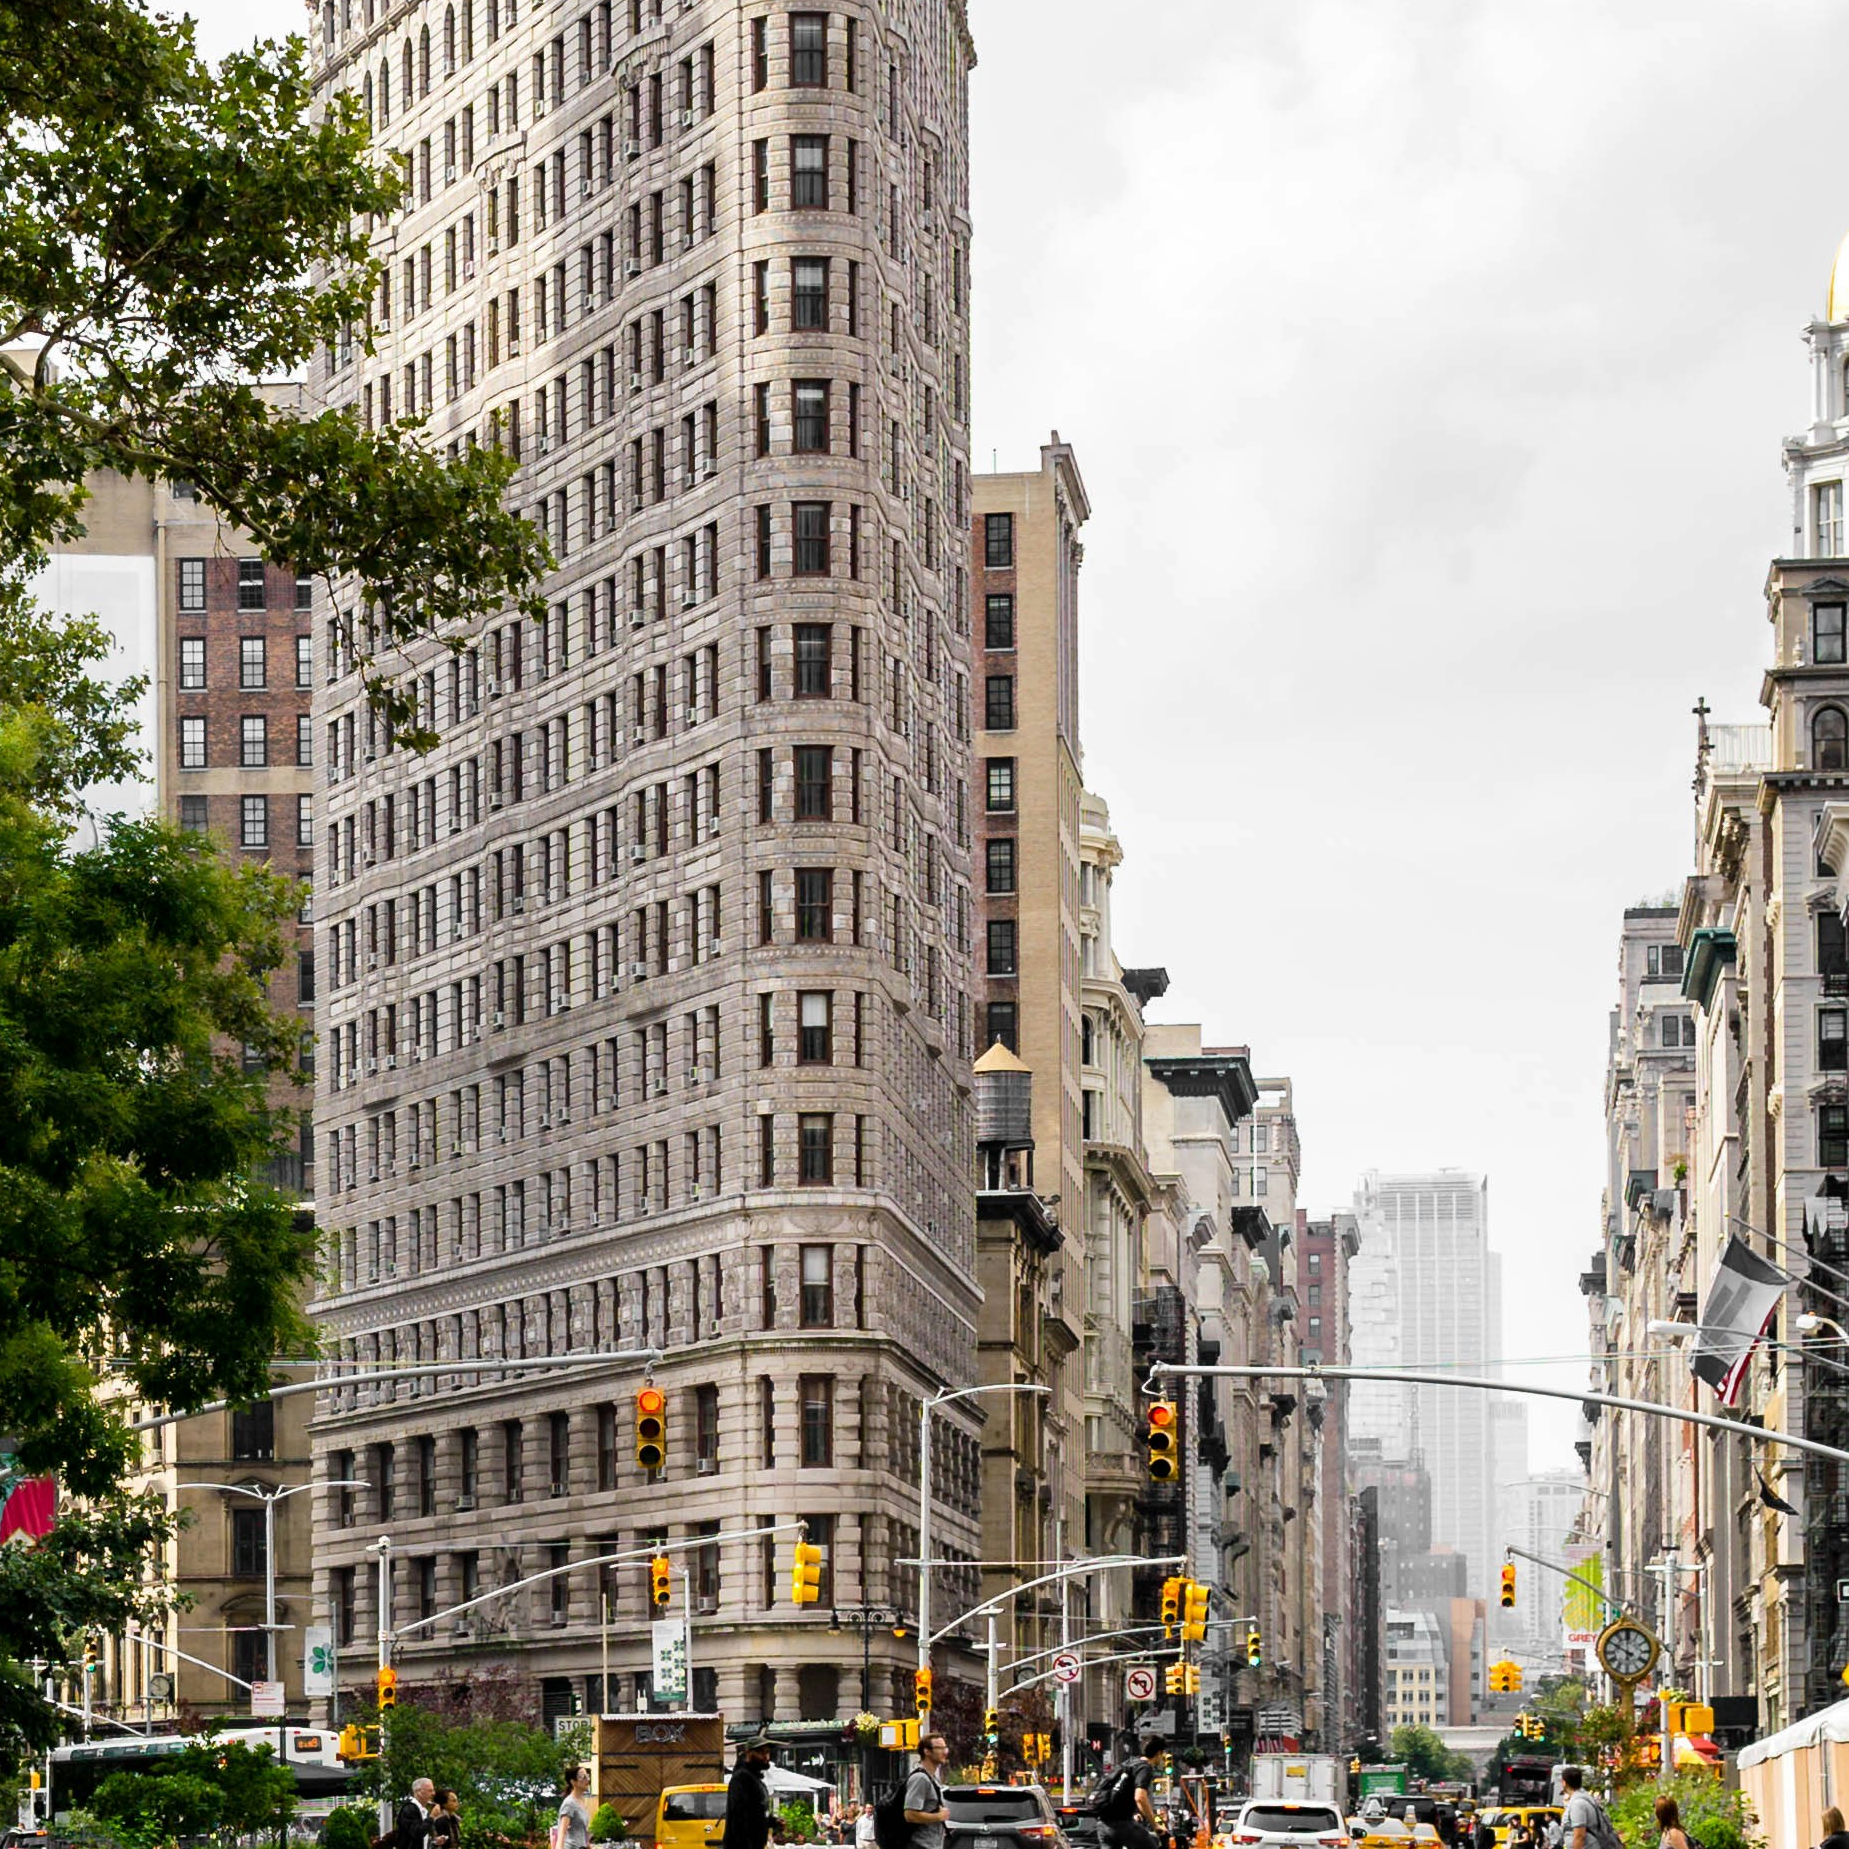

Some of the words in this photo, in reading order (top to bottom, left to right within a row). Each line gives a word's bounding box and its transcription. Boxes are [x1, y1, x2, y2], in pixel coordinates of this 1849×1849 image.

[1568, 1633, 1597, 1643] GREY
[558, 1720, 589, 1731] STOP
[636, 1724, 686, 1744] BOX
